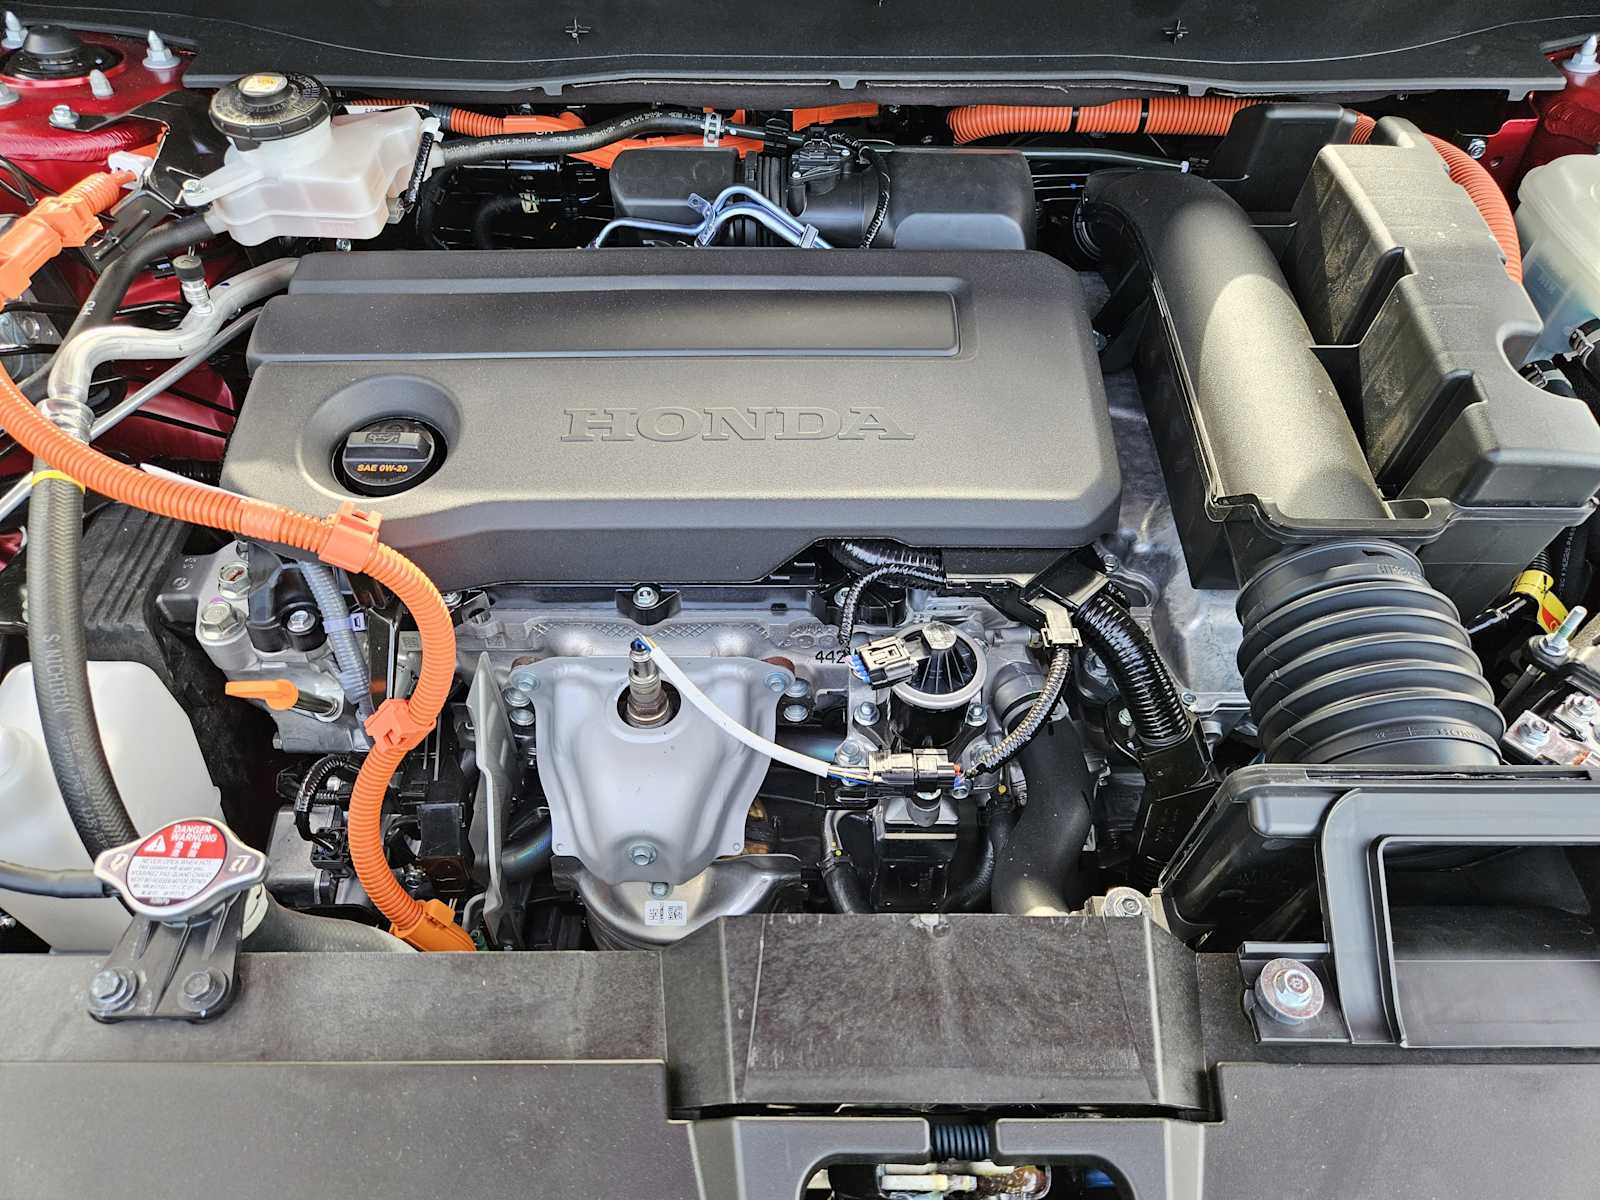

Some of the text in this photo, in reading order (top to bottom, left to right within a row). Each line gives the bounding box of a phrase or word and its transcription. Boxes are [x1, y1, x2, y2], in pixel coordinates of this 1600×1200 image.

[560, 407, 915, 442] HONDA
[356, 463, 409, 473] SAE 0W-20
[172, 824, 212, 833] DANGER
[171, 832, 217, 842] WARNUNG
